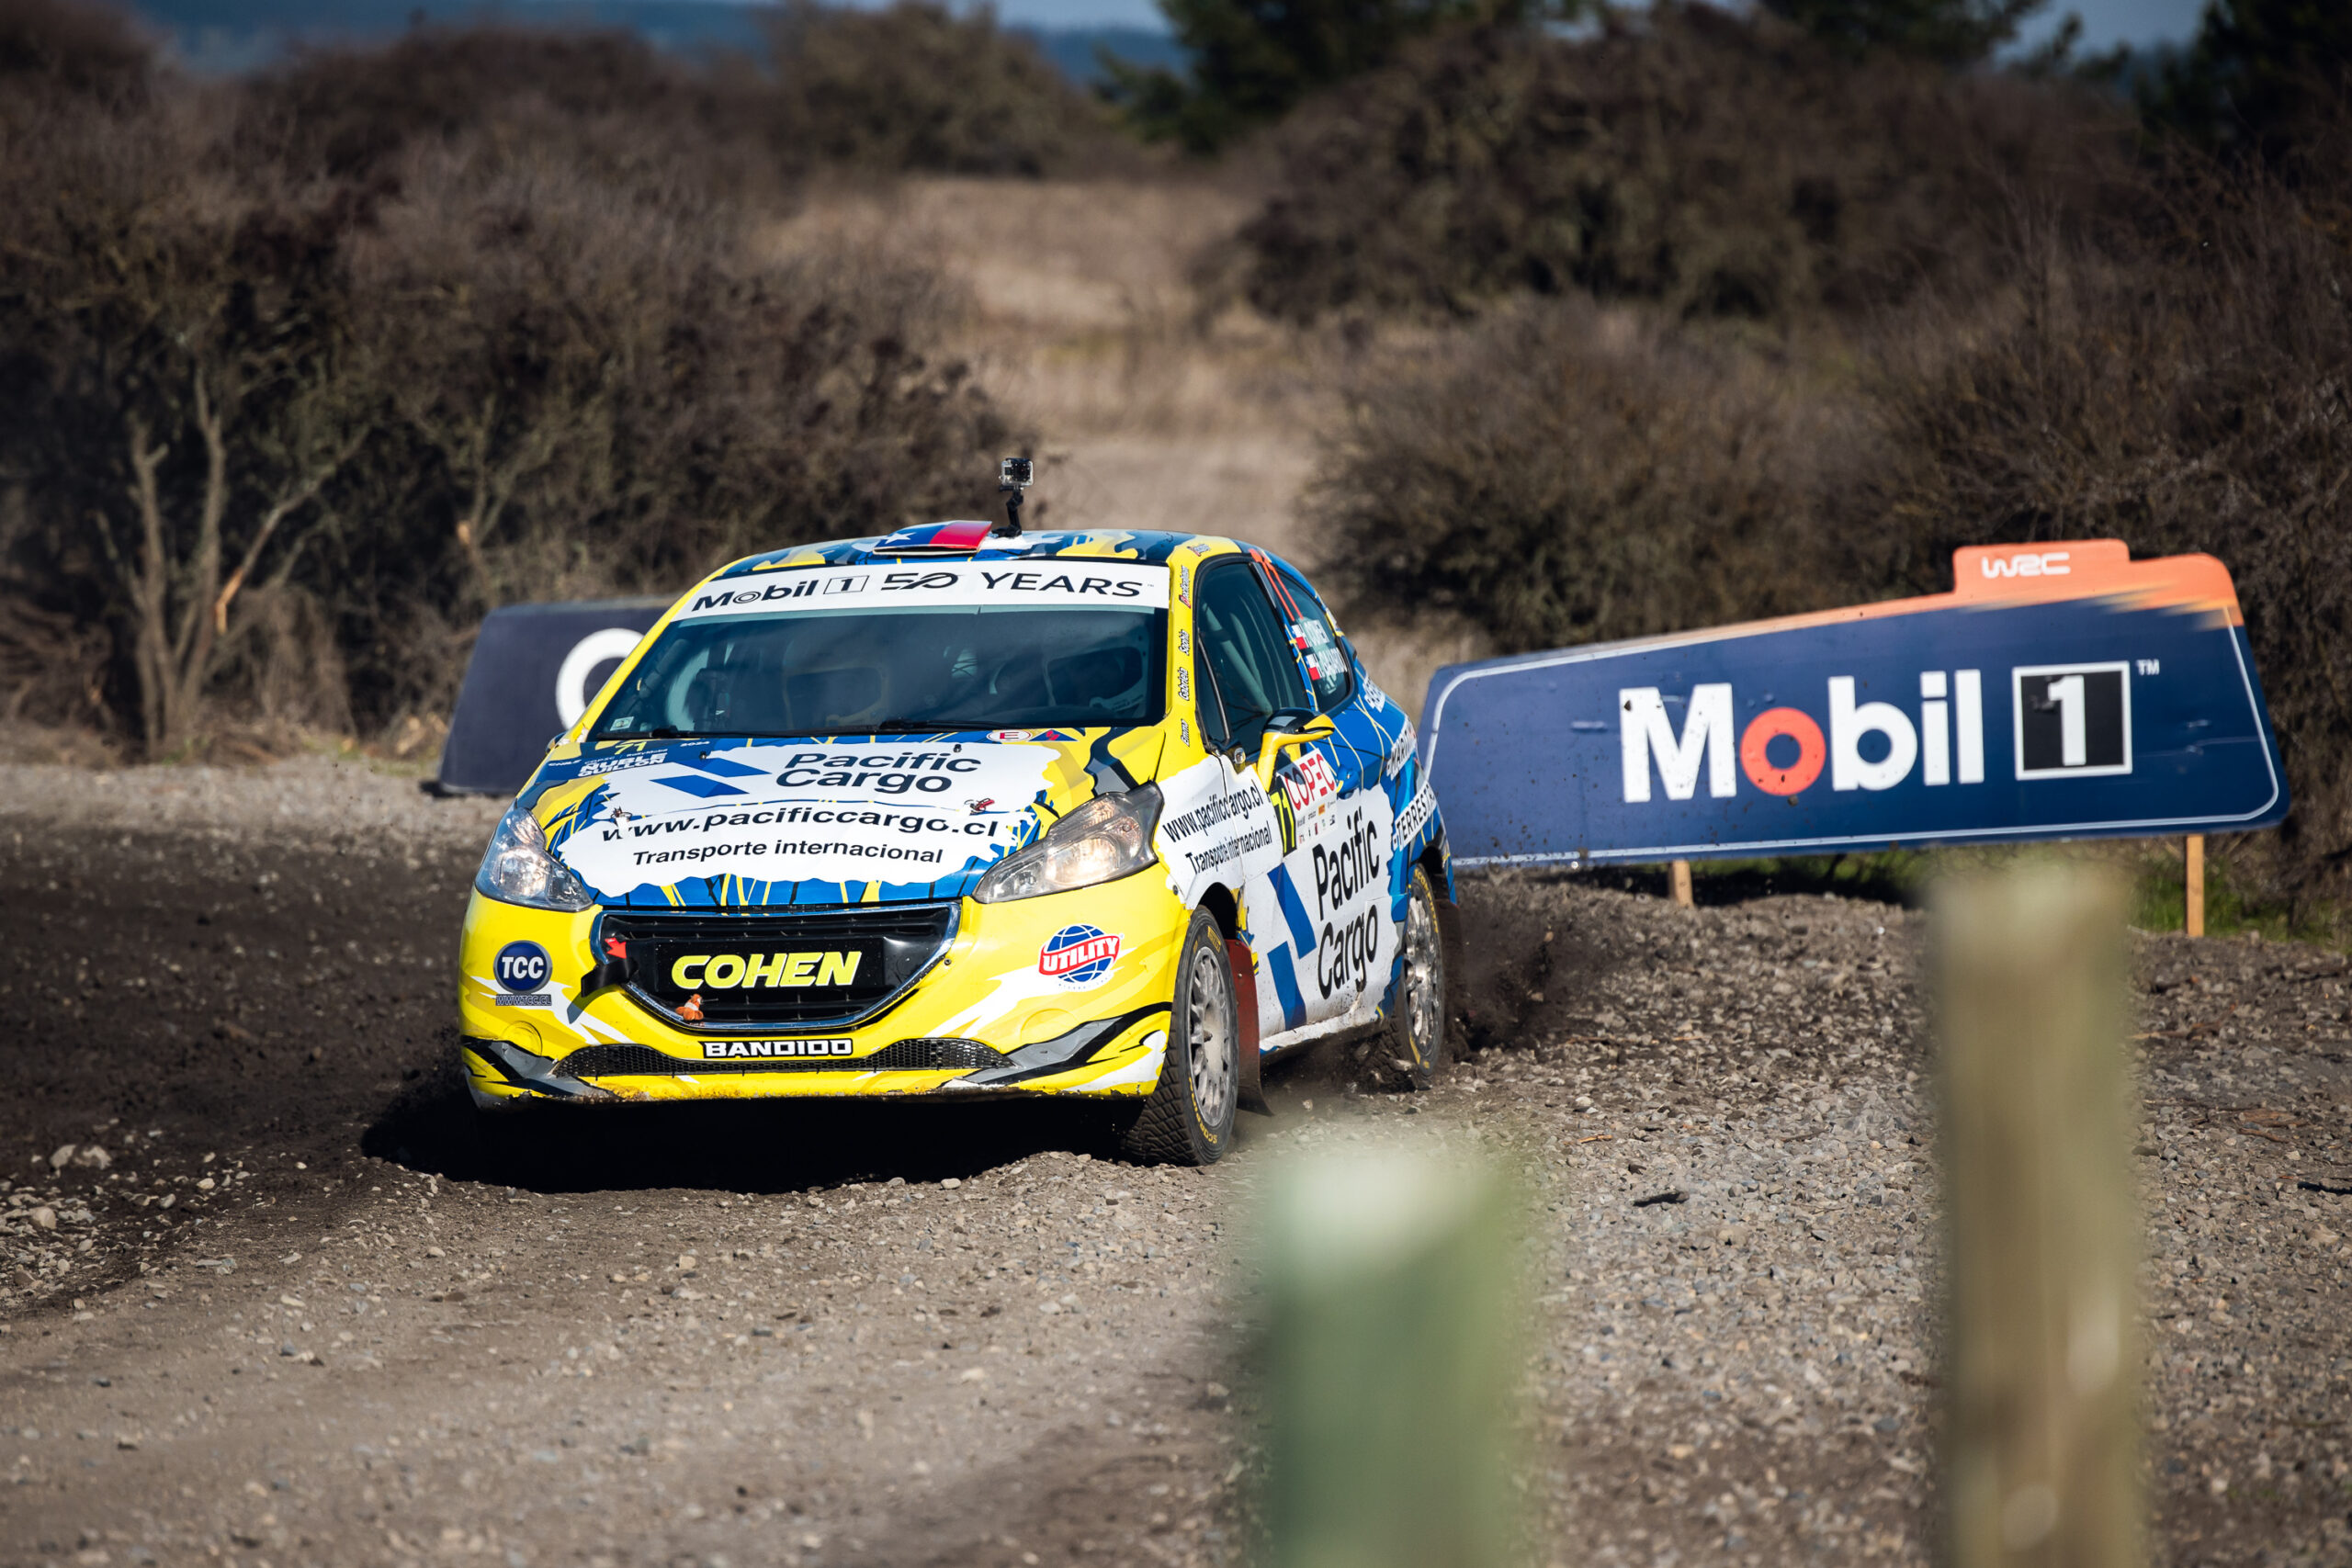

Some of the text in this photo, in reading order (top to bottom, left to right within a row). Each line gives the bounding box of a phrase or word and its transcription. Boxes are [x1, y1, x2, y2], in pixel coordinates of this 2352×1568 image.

[1982, 552, 2071, 578] WRC
[692, 580, 819, 612] Mobil
[881, 572, 957, 590] 50
[981, 572, 1143, 597] YEARS
[1177, 667, 1190, 701] Gabriela
[614, 741, 647, 755] 71
[1619, 669, 1984, 804] Mobil
[2048, 675, 2086, 766] 1
[785, 751, 981, 773] Pacific
[776, 769, 952, 794] Cargo
[1284, 754, 1335, 810] COPEC
[603, 807, 998, 841] www.pacificcargo.cl
[1270, 787, 1295, 853] 71
[633, 840, 944, 865] Transporte internacional
[1313, 806, 1379, 921] Pacific
[502, 956, 544, 979] TCC
[1042, 937, 1119, 972] UTILITY
[1317, 905, 1377, 999] Cargo
[672, 951, 862, 989] COHEN
[496, 995, 551, 1005] WWW.TCC.CL
[704, 1040, 852, 1057] BANDIDO
